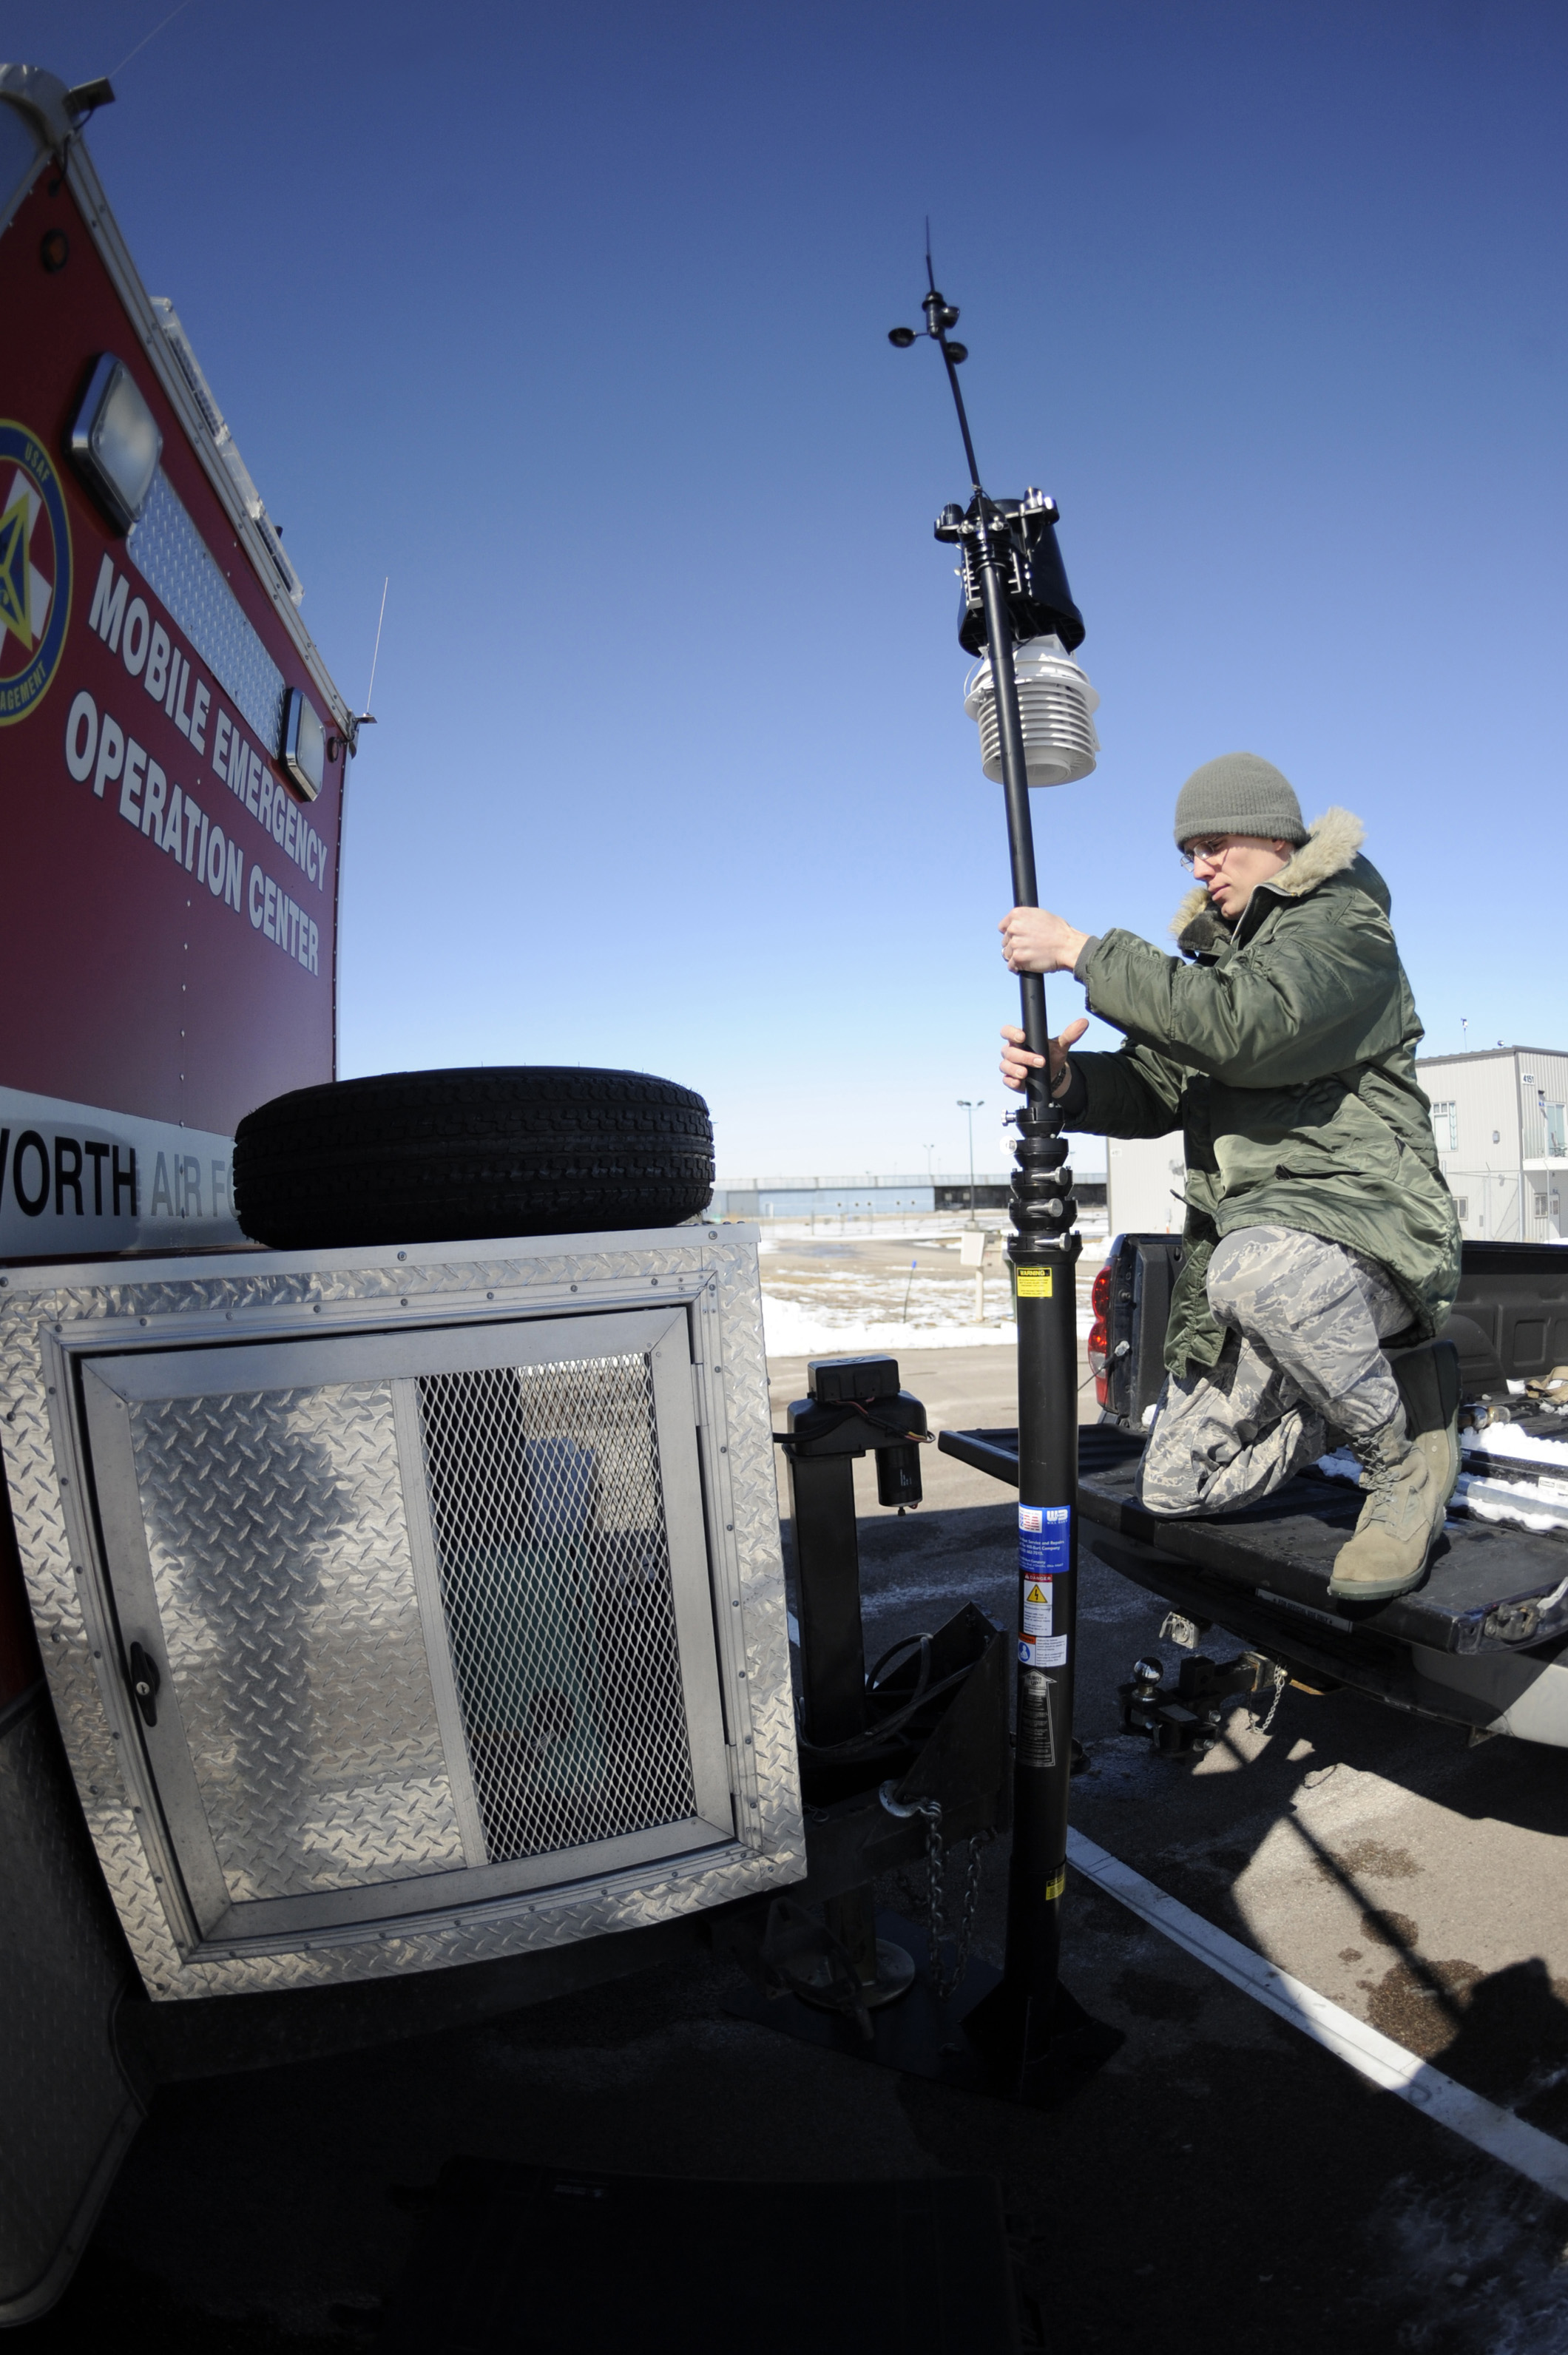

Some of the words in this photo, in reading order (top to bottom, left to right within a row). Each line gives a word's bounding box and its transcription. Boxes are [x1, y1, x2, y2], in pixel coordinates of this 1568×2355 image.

[24, 442, 50, 483] USAF
[88, 552, 211, 756] MOBILE
[212, 707, 328, 892] EMERGENCY
[65, 689, 243, 914] OPERATION
[248, 864, 320, 977] CENTER
[1523, 1074, 1535, 1084] 4151
[151, 1150, 203, 1217] AIR
